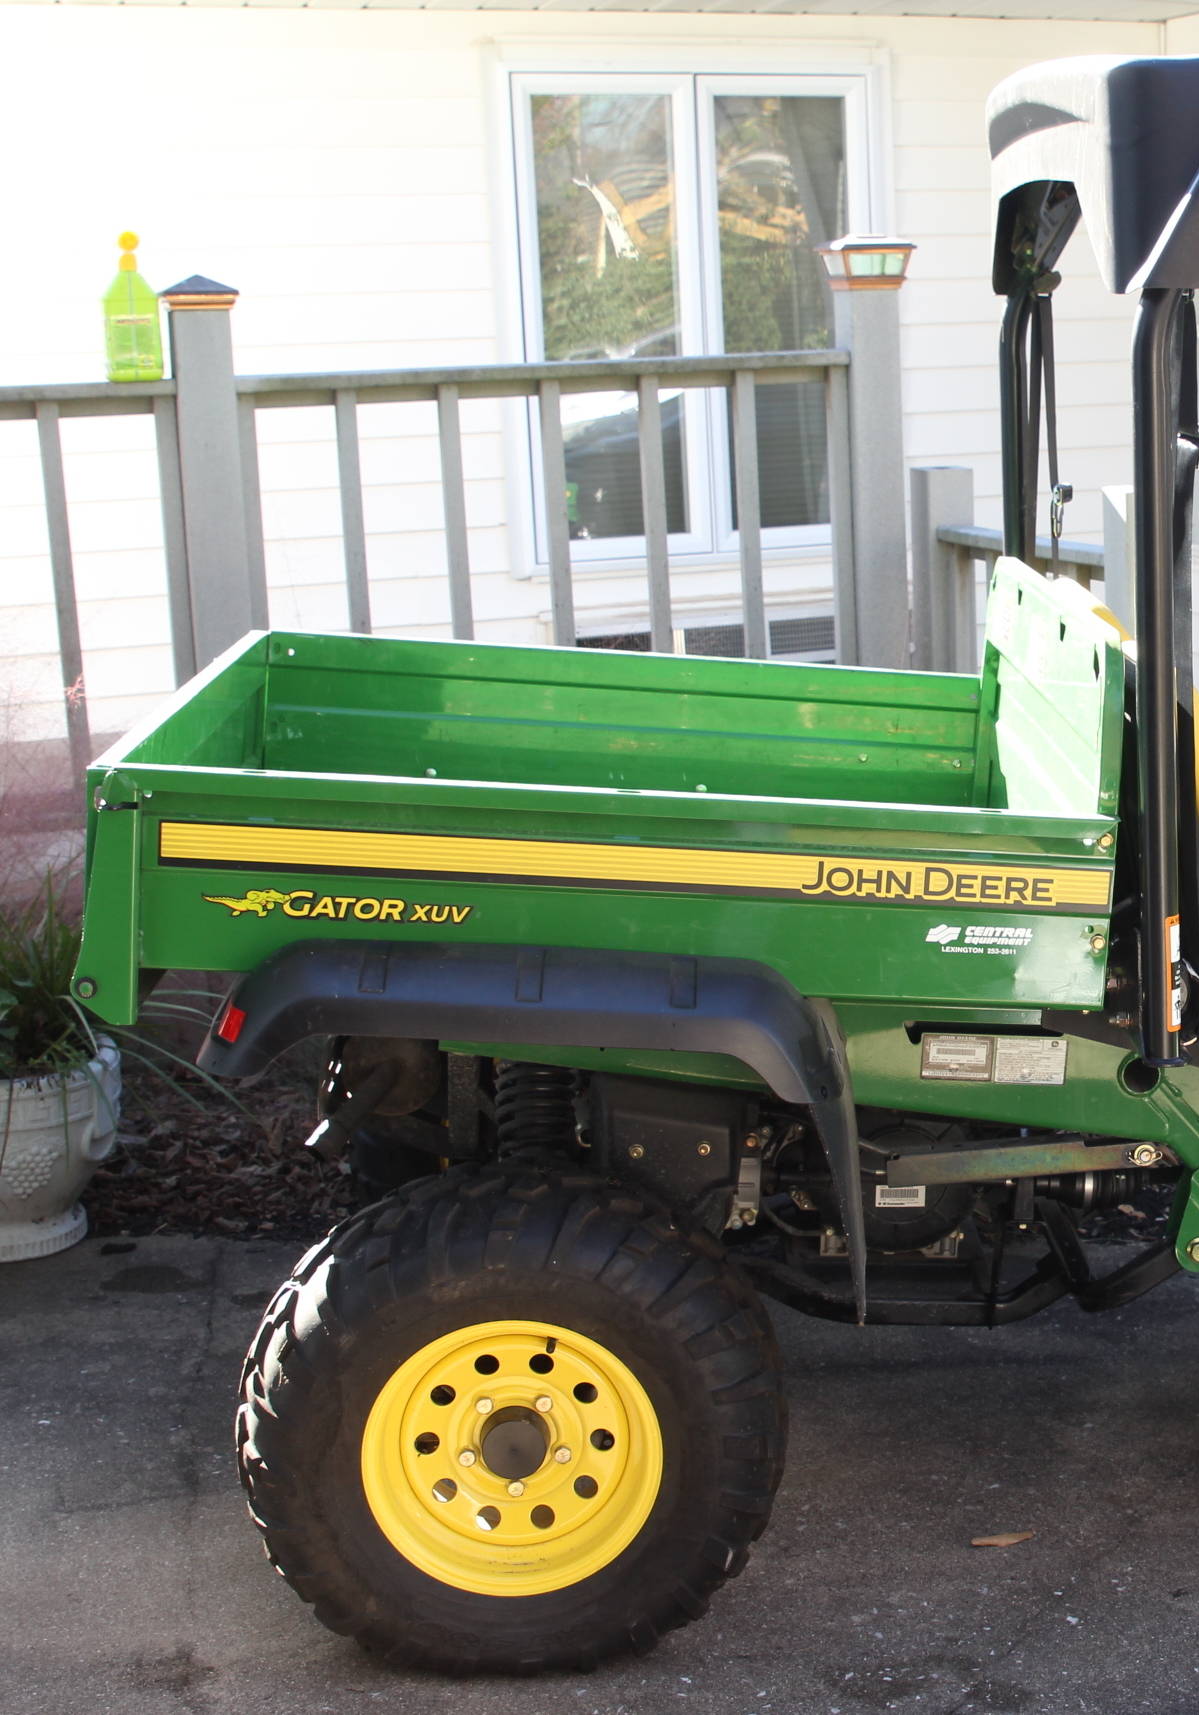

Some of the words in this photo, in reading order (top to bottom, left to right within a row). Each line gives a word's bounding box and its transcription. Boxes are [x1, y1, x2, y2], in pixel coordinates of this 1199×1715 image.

[801, 860, 914, 898] JOHN
[922, 866, 1056, 905] DEERE
[282, 890, 406, 922] GATOR
[410, 903, 472, 924] XUV
[964, 925, 1034, 938] CENTRAL
[963, 936, 1032, 946] EQUIPMENT
[941, 945, 984, 954] LEXINGTON
